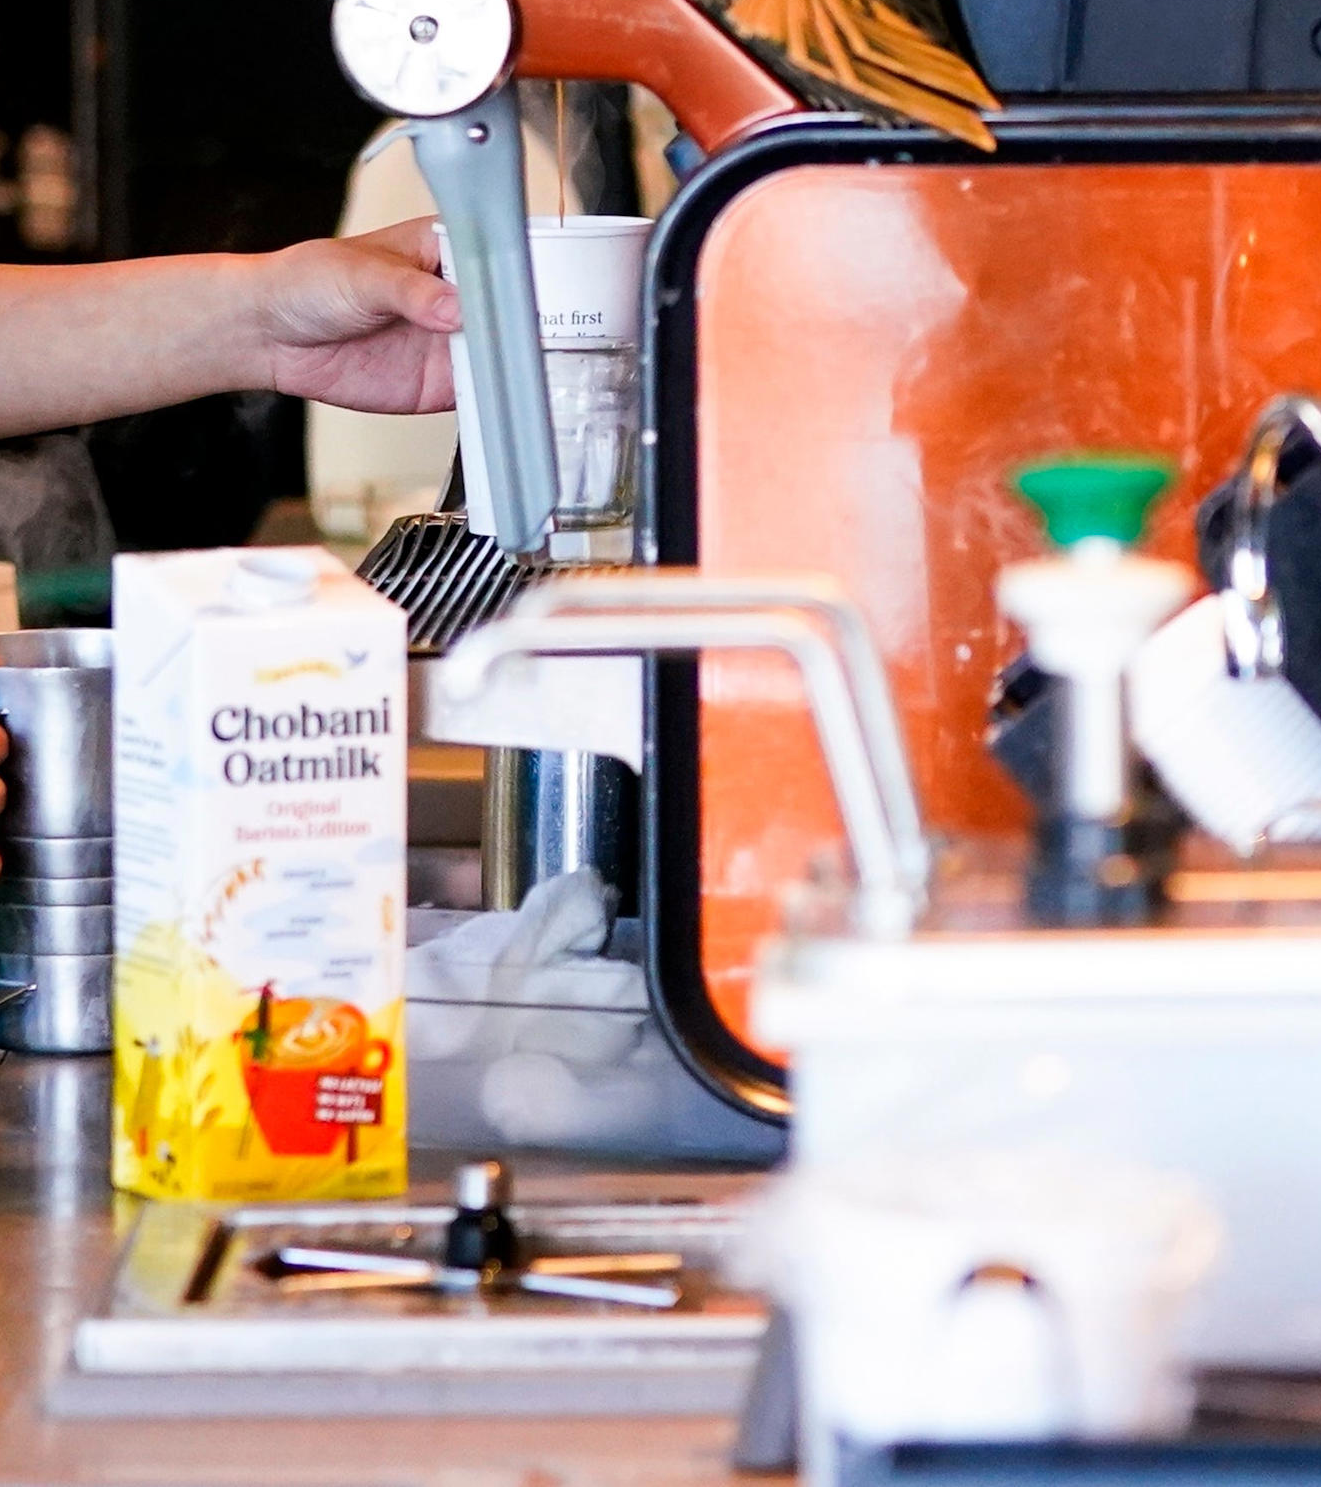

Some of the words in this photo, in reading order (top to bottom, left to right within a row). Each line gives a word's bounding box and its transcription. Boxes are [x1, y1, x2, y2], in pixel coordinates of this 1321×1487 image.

[538, 311, 564, 325] hat
[571, 310, 602, 325] first
[212, 696, 390, 743] Chobani
[224, 746, 381, 787] Oatmilk
